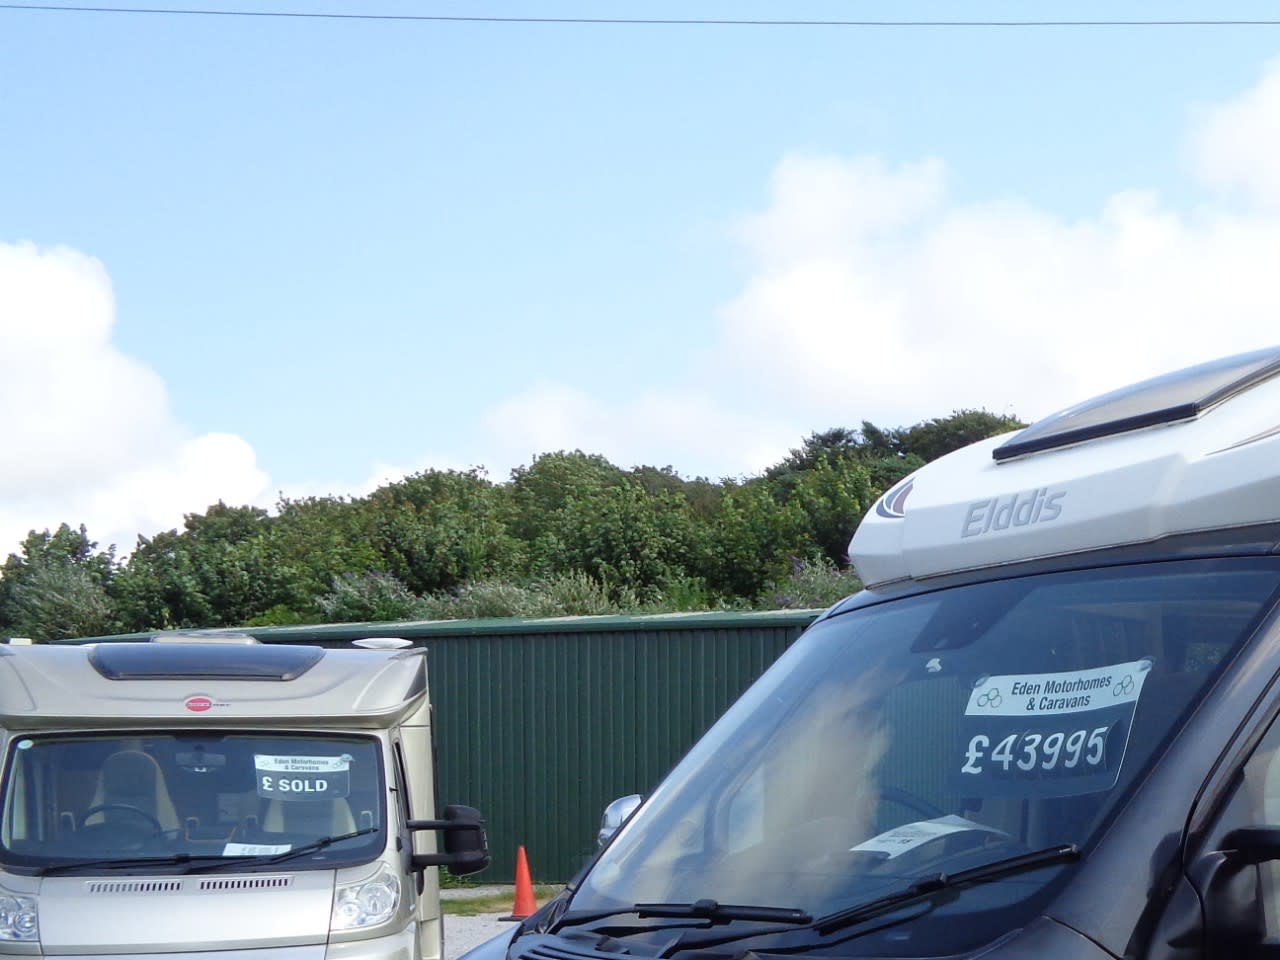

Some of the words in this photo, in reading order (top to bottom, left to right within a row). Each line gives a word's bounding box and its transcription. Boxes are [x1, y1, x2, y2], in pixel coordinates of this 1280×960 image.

[960, 487, 1067, 538] Elddis
[1011, 681, 1041, 696] Eden
[1043, 675, 1112, 694] Motorhomes
[1026, 697, 1036, 711] &
[1038, 694, 1091, 711] Caravans
[961, 726, 1109, 774] £43995
[278, 779, 328, 792] SOLD
